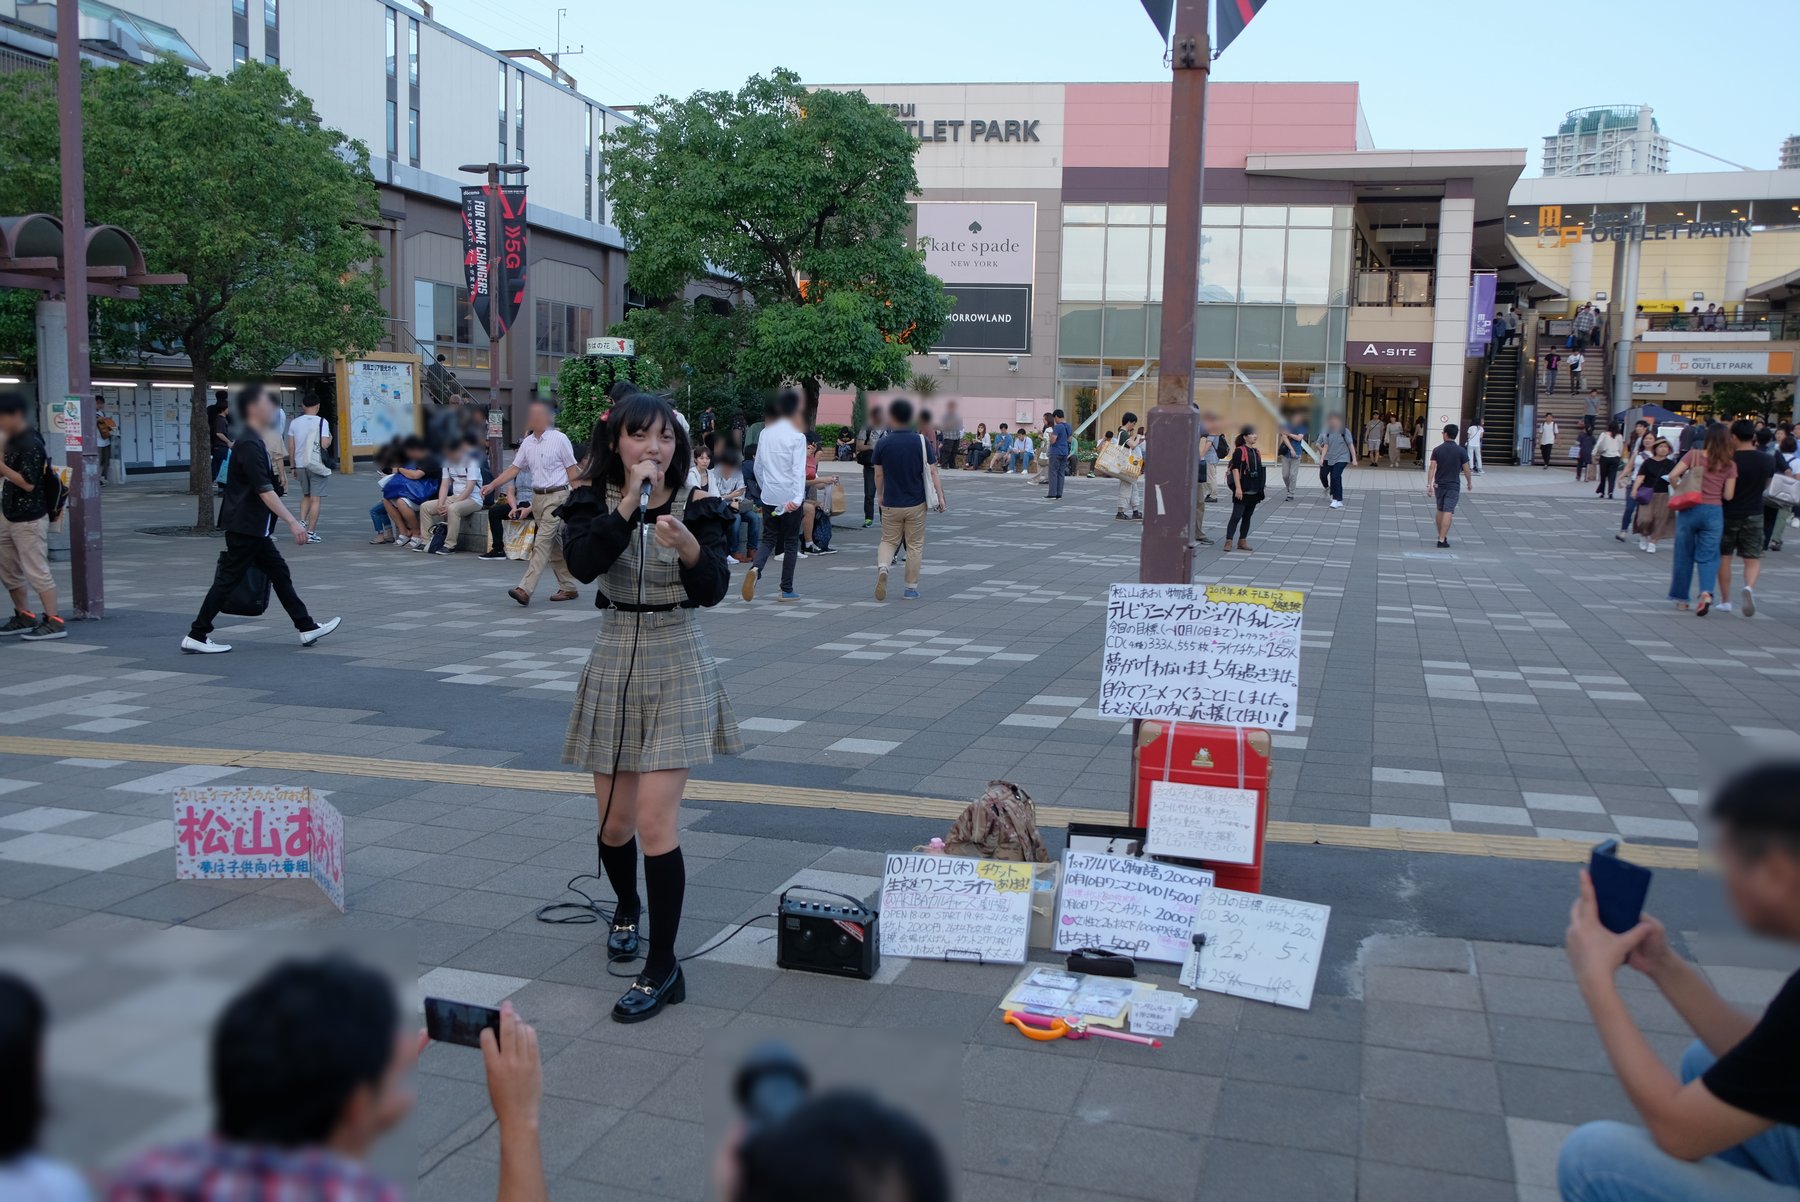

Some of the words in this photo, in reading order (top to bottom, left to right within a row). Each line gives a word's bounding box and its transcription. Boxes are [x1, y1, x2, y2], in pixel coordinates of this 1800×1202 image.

[899, 120, 964, 142] TLET
[970, 120, 1040, 142] PARK
[474, 200, 486, 219] FOR
[475, 220, 487, 246] GAME
[1590, 222, 1680, 244] OUTLET
[1687, 219, 1753, 240] PARK
[505, 239, 521, 270] 5G
[931, 238, 965, 252] kate
[971, 238, 1020, 256] spade
[476, 247, 488, 295] CHANGERS
[945, 313, 1012, 323] MORROWLAND
[1729, 362, 1753, 370] PARK
[199, 860, 309, 874] 夢は子供向け番組
[887, 856, 975, 876] 10月10日(木)
[981, 863, 1018, 878] チケット
[882, 910, 907, 919] OPEN
[934, 911, 962, 919] START
[1200, 909, 1216, 921] CD
[1059, 929, 1101, 947] はちまき
